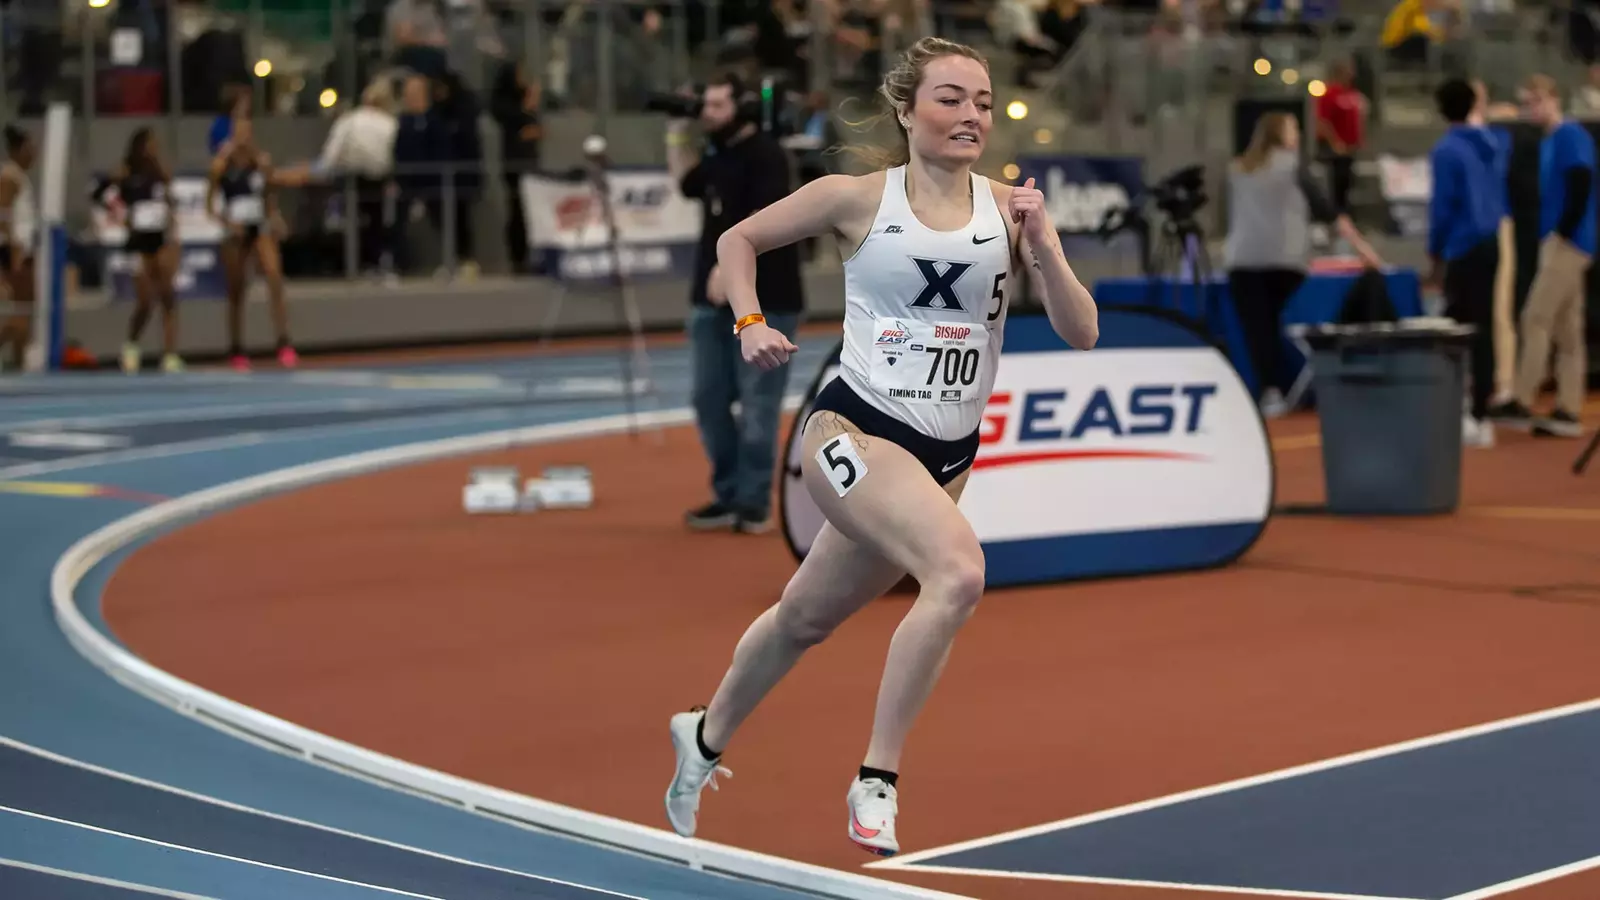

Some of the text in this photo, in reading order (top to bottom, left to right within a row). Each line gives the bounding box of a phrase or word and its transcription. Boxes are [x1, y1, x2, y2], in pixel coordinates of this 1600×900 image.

[906, 255, 979, 313] X
[987, 272, 1007, 321] 5
[877, 336, 909, 344] EAST
[934, 325, 971, 340] BISHOP
[926, 347, 979, 386] 700
[889, 388, 916, 399] TIMING
[917, 390, 932, 400] TAG
[1017, 384, 1217, 441] EAST
[822, 439, 856, 489] 5
